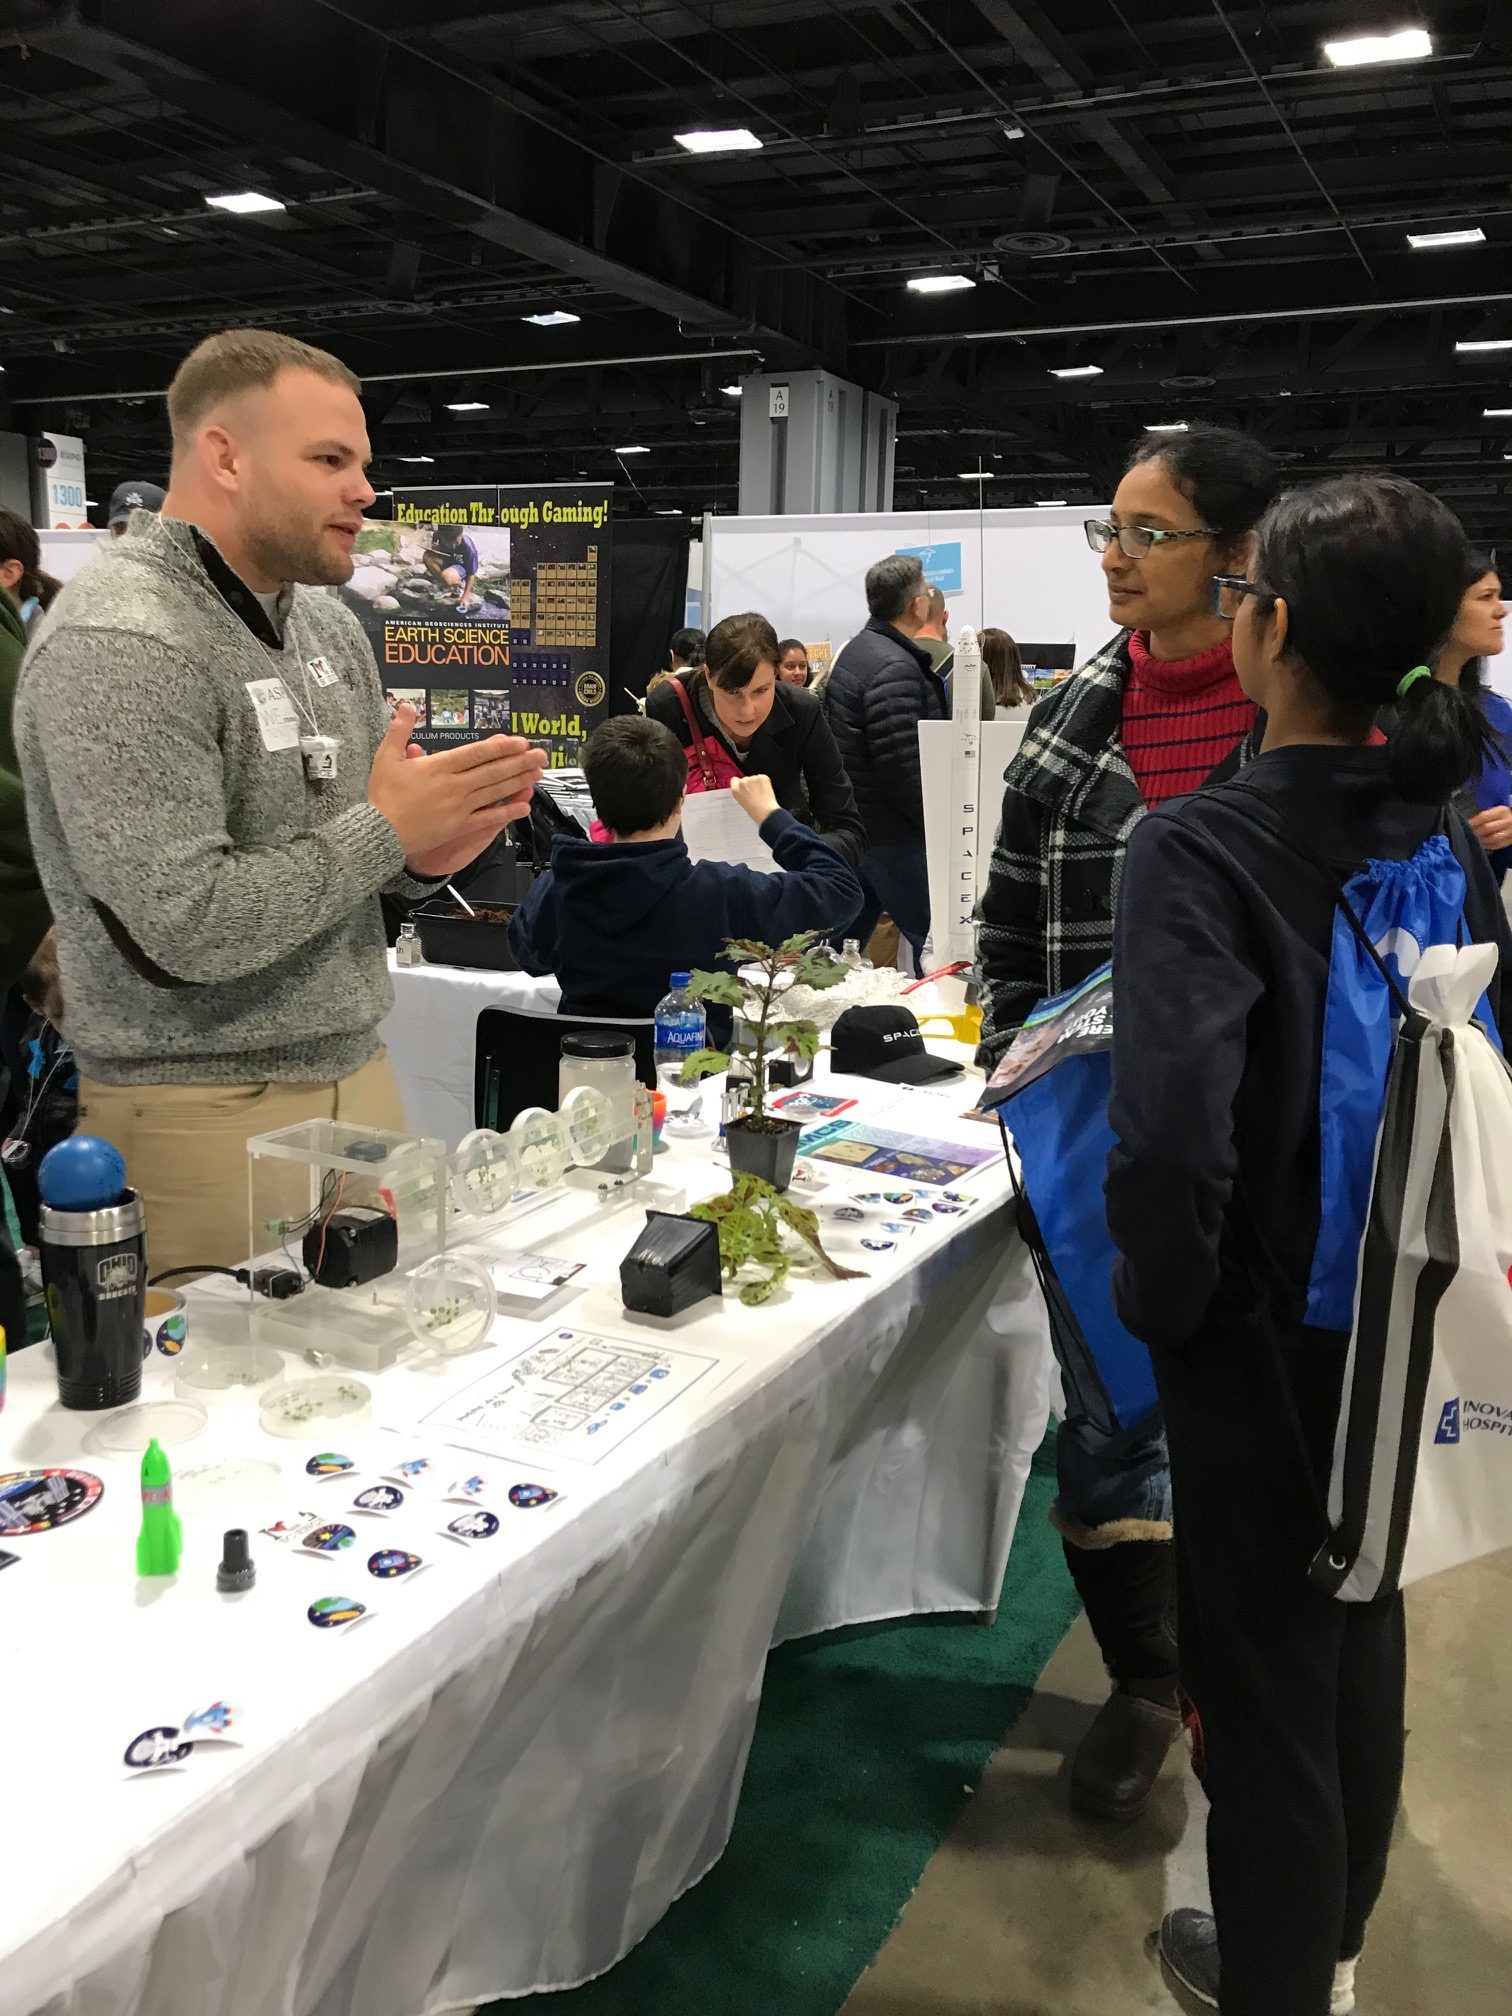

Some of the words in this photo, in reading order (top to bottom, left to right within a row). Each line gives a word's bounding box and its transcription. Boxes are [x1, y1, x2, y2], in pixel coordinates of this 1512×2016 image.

[776, 390, 784, 401] A
[774, 402, 786, 414] 19
[52, 484, 83, 508] 1300
[397, 502, 468, 524] Education
[542, 500, 609, 529] Gaming!
[384, 626, 439, 643] EARTH
[444, 628, 509, 645] SCIENCE
[385, 643, 510, 666] EDUCATION
[409, 732, 438, 740] CULUM
[440, 732, 480, 740] PRODUCTS
[521, 712, 587, 742] World,
[959, 804, 975, 925] SPACEX
